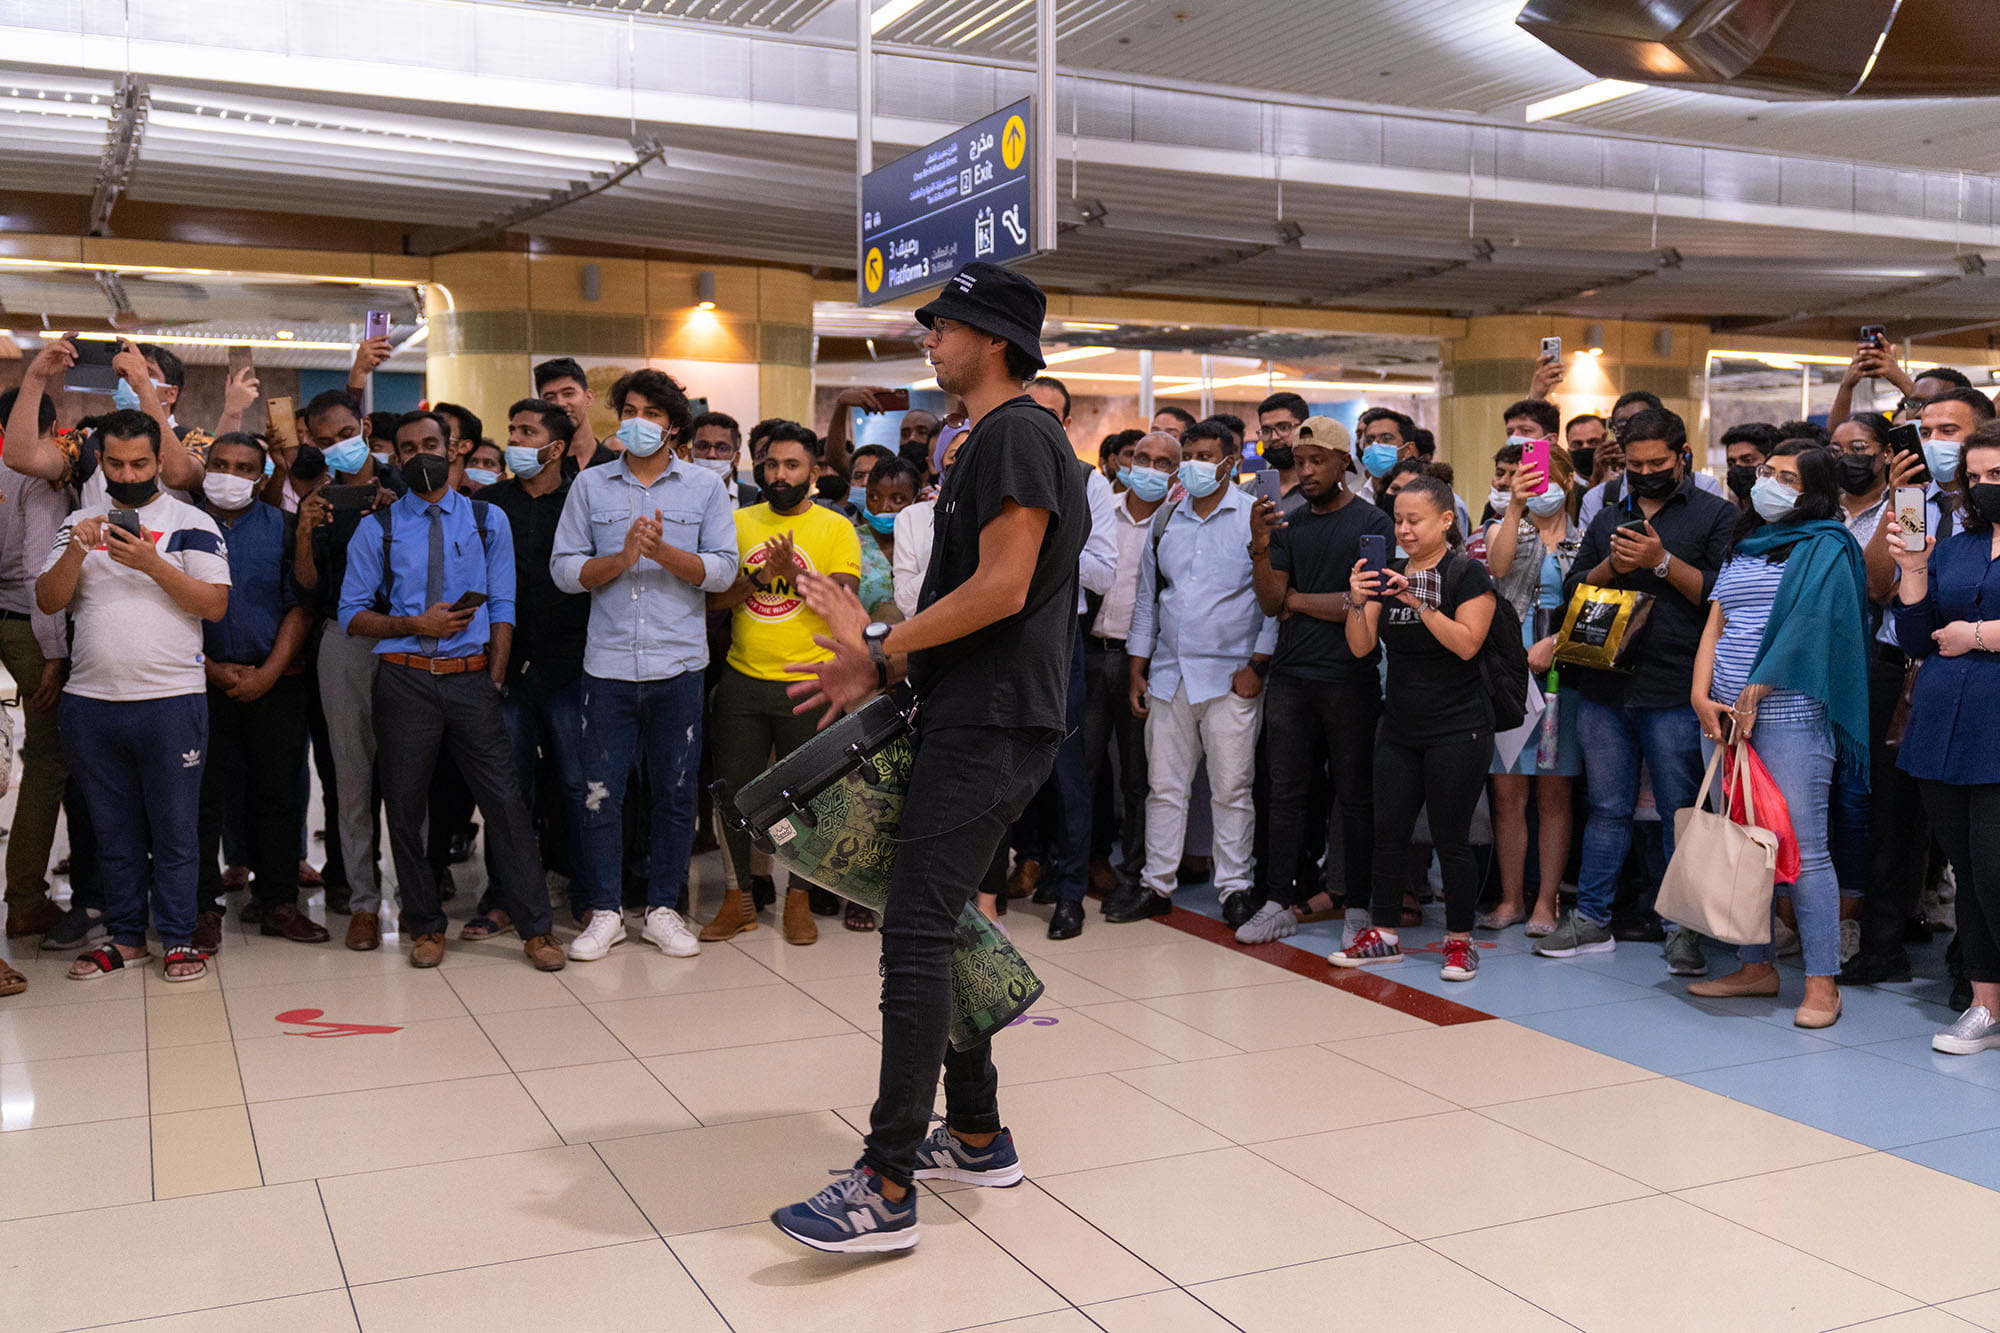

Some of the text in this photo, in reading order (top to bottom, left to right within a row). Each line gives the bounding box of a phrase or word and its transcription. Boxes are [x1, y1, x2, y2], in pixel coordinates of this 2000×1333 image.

[969, 132, 994, 161] مخرج
[974, 160, 994, 185] Exit
[888, 241, 895, 260] 3
[888, 257, 930, 288] Platform 3
[758, 604, 771, 614] THE
[772, 601, 793, 614] WALL
